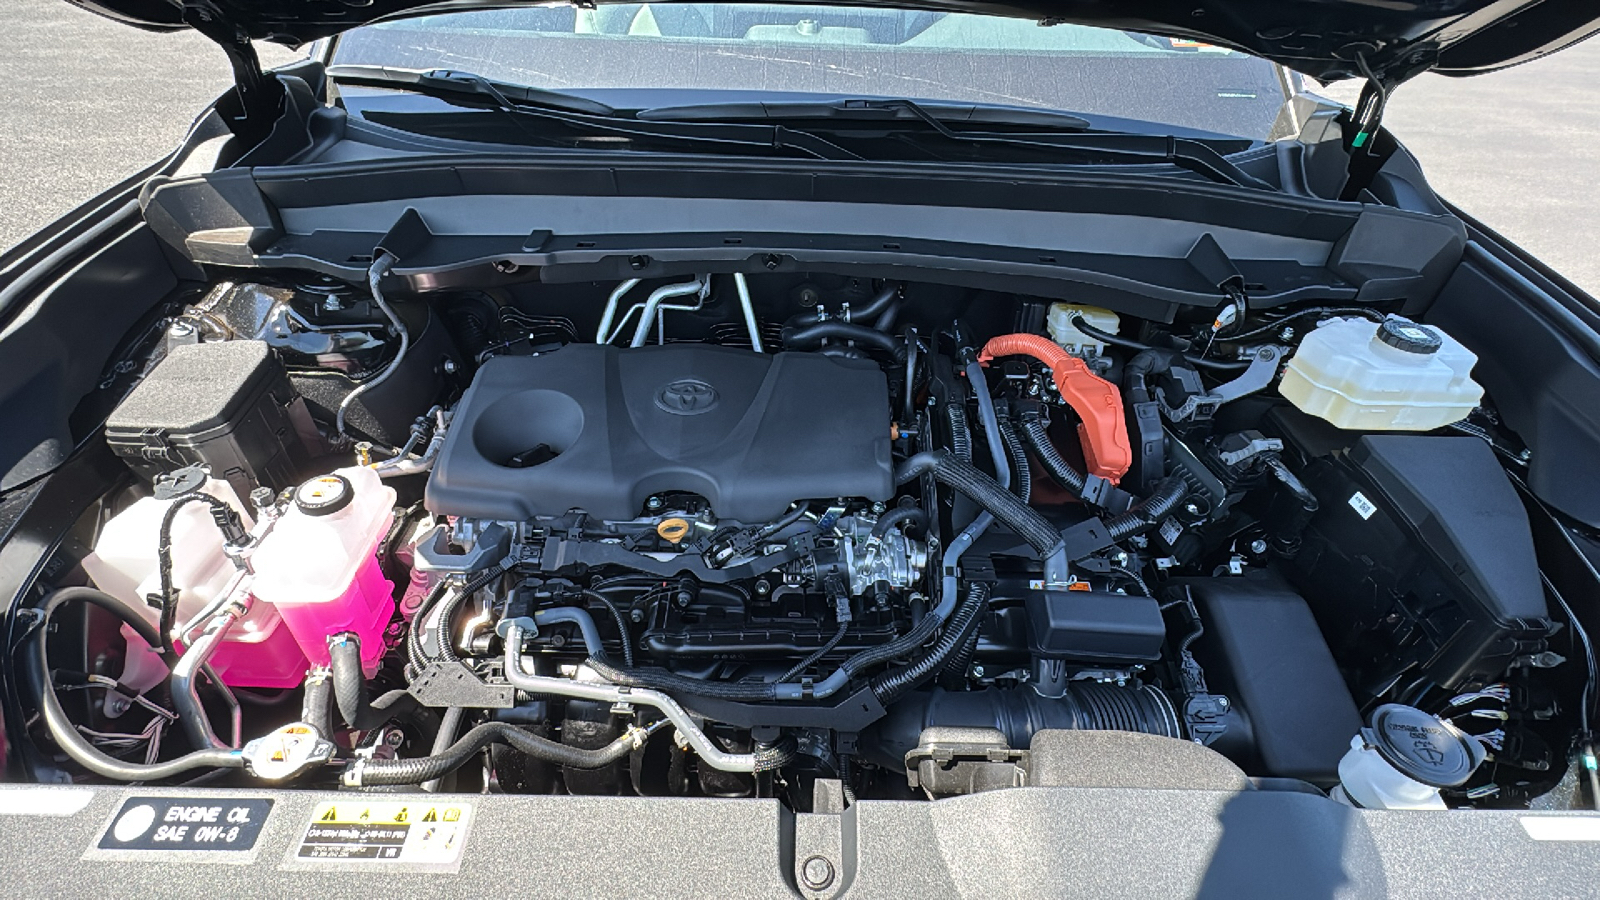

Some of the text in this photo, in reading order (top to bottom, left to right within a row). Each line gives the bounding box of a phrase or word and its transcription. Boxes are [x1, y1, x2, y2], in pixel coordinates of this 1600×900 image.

[164, 806, 251, 823] ENGINE OIL
[153, 825, 240, 842] SAE 0W-8
